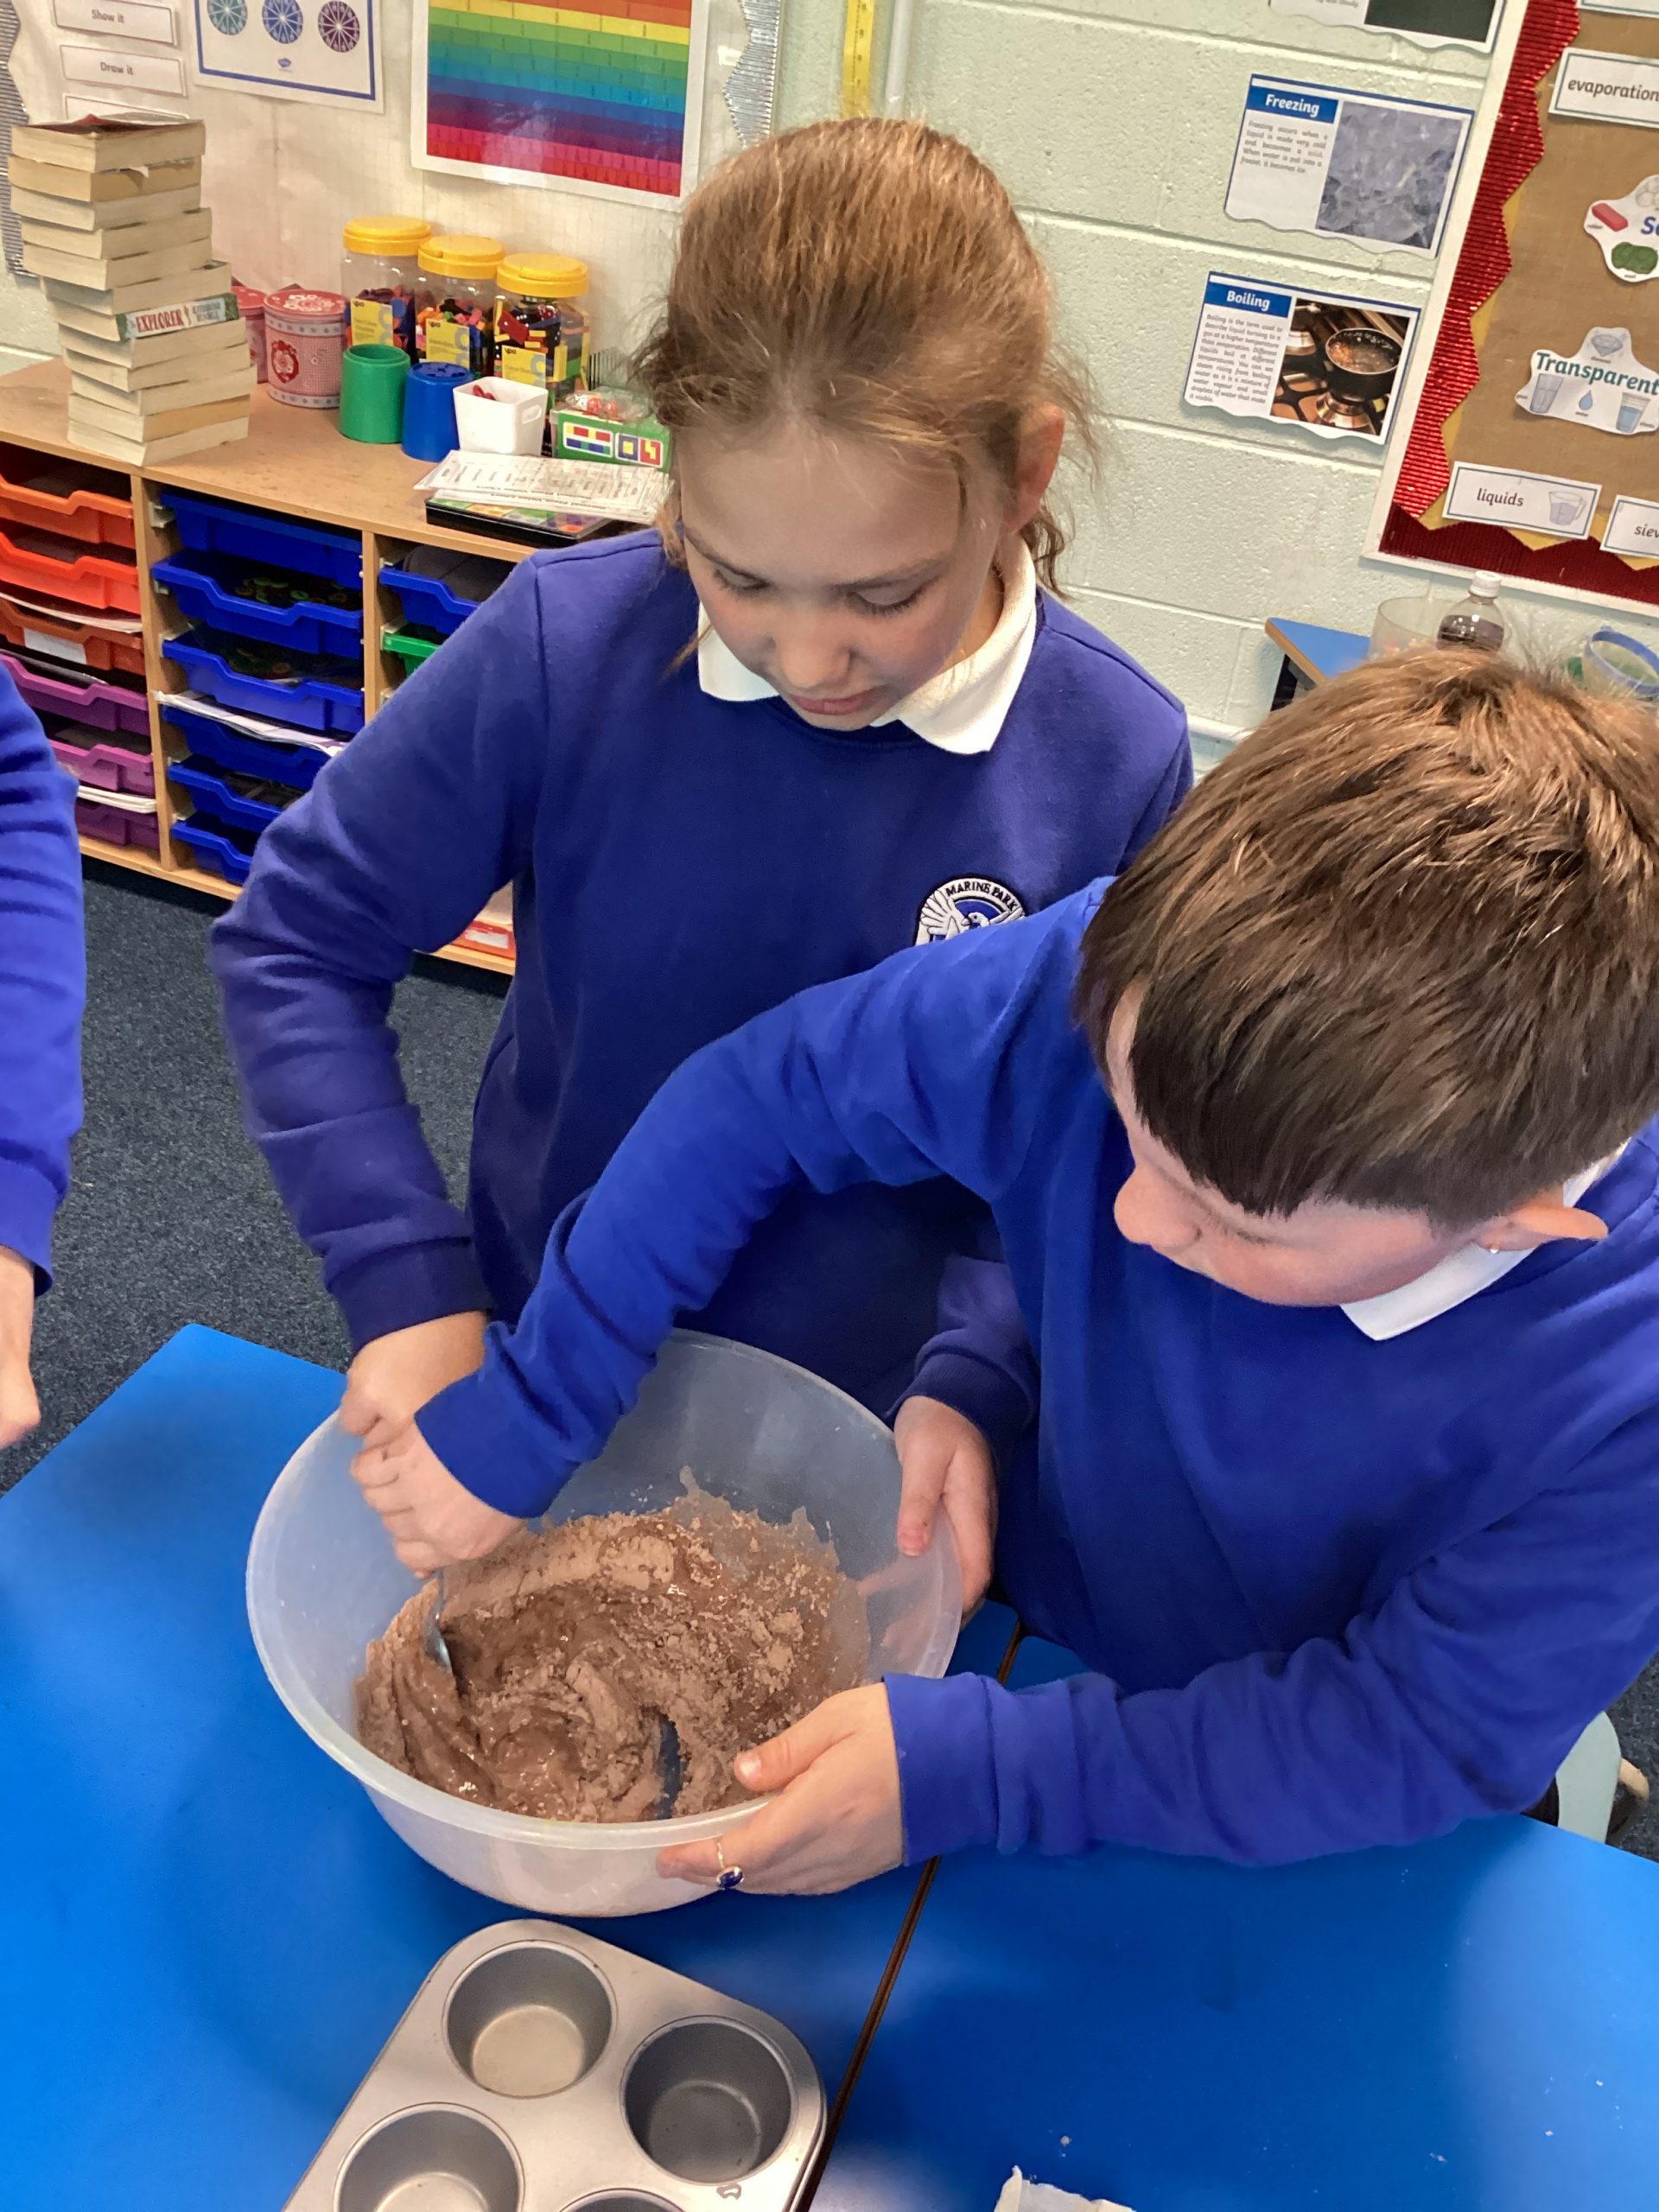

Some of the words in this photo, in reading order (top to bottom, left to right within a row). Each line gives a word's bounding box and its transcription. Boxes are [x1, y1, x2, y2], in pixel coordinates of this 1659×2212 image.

[92, 10, 114, 22] Show
[118, 14, 124, 23] it
[127, 65, 133, 75] it
[1567, 78, 1659, 103] evaporation
[1265, 94, 1319, 118] Freezing
[1227, 290, 1269, 311] Boiling
[136, 309, 184, 332] EXPLORER
[1536, 351, 1659, 397] Transparent
[1477, 487, 1523, 506] liquids
[945, 881, 991, 897] MARINE
[991, 887, 1018, 911] PARK
